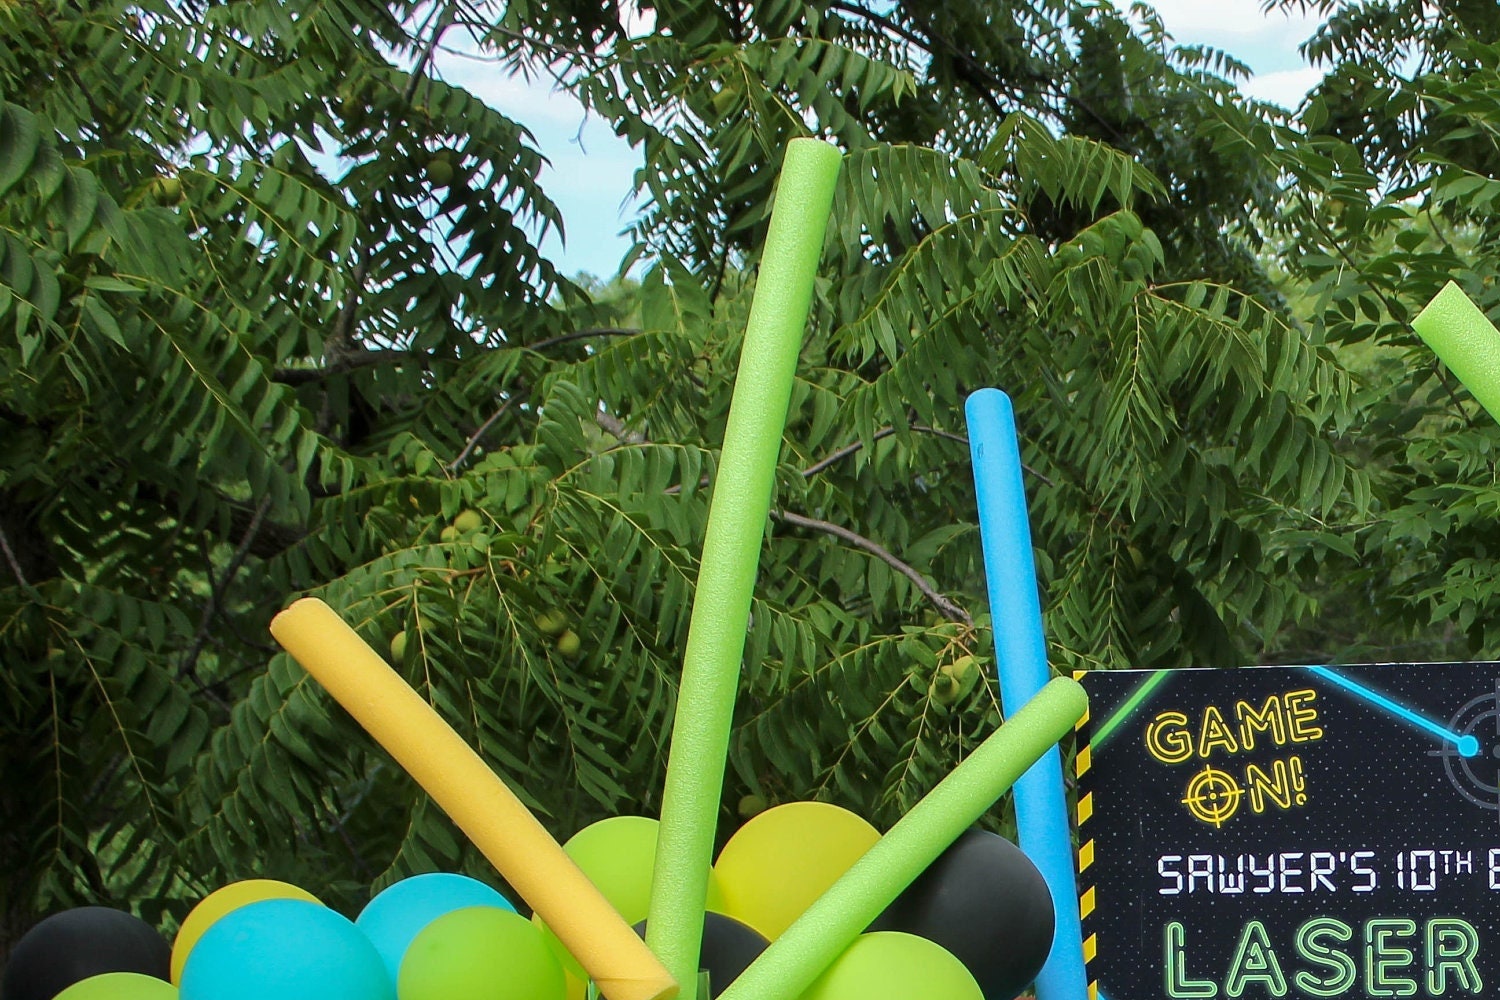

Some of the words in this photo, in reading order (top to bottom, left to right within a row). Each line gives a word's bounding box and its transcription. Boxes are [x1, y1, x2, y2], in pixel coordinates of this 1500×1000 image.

[1146, 689, 1324, 764] GAME
[1181, 756, 1308, 830] ON!
[1156, 850, 1378, 896] SAWYER'S
[1166, 917, 1484, 998] LASER
